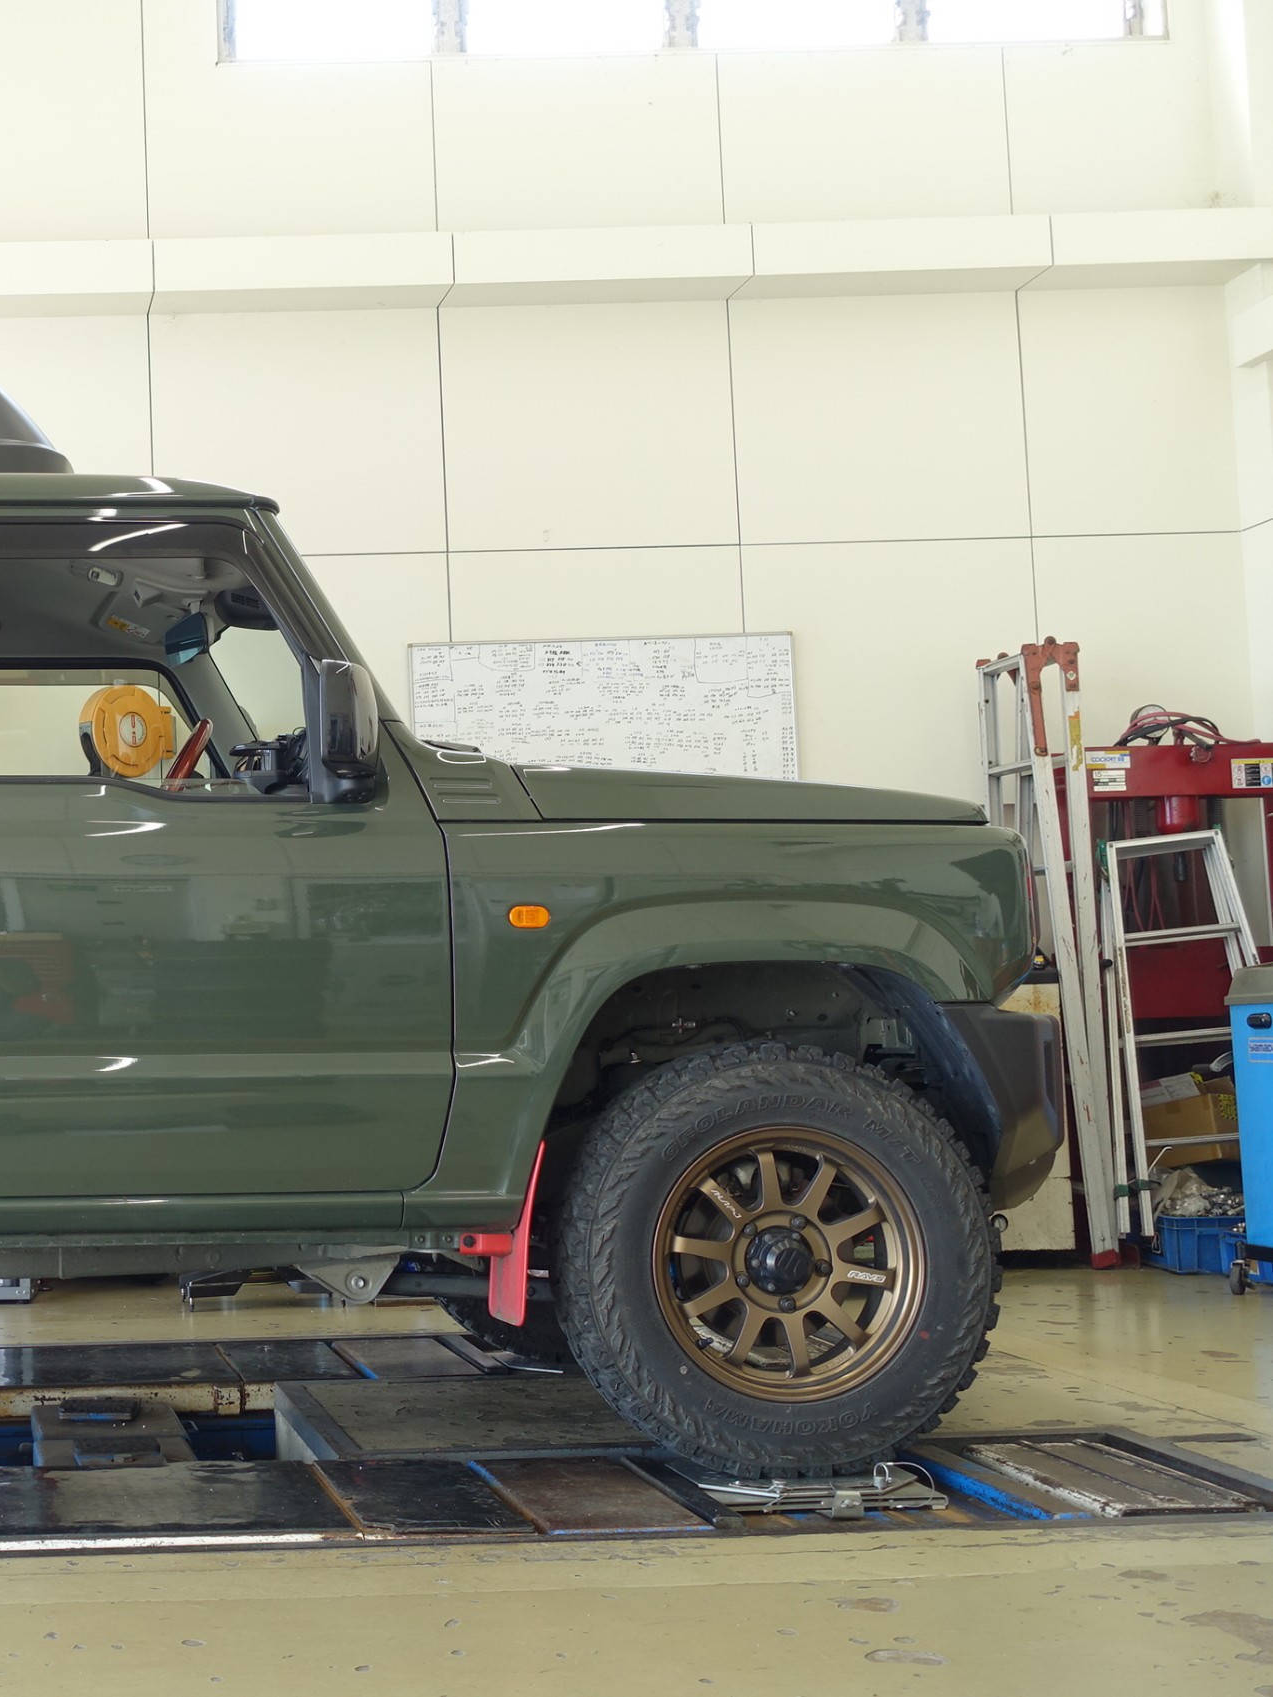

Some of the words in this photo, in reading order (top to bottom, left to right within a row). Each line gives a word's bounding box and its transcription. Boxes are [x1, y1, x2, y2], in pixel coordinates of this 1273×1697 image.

[662, 1093, 854, 1162] GEOLANDAR
[847, 1270, 887, 1283] RAYS
[704, 1400, 879, 1435] YOKOHAMA
